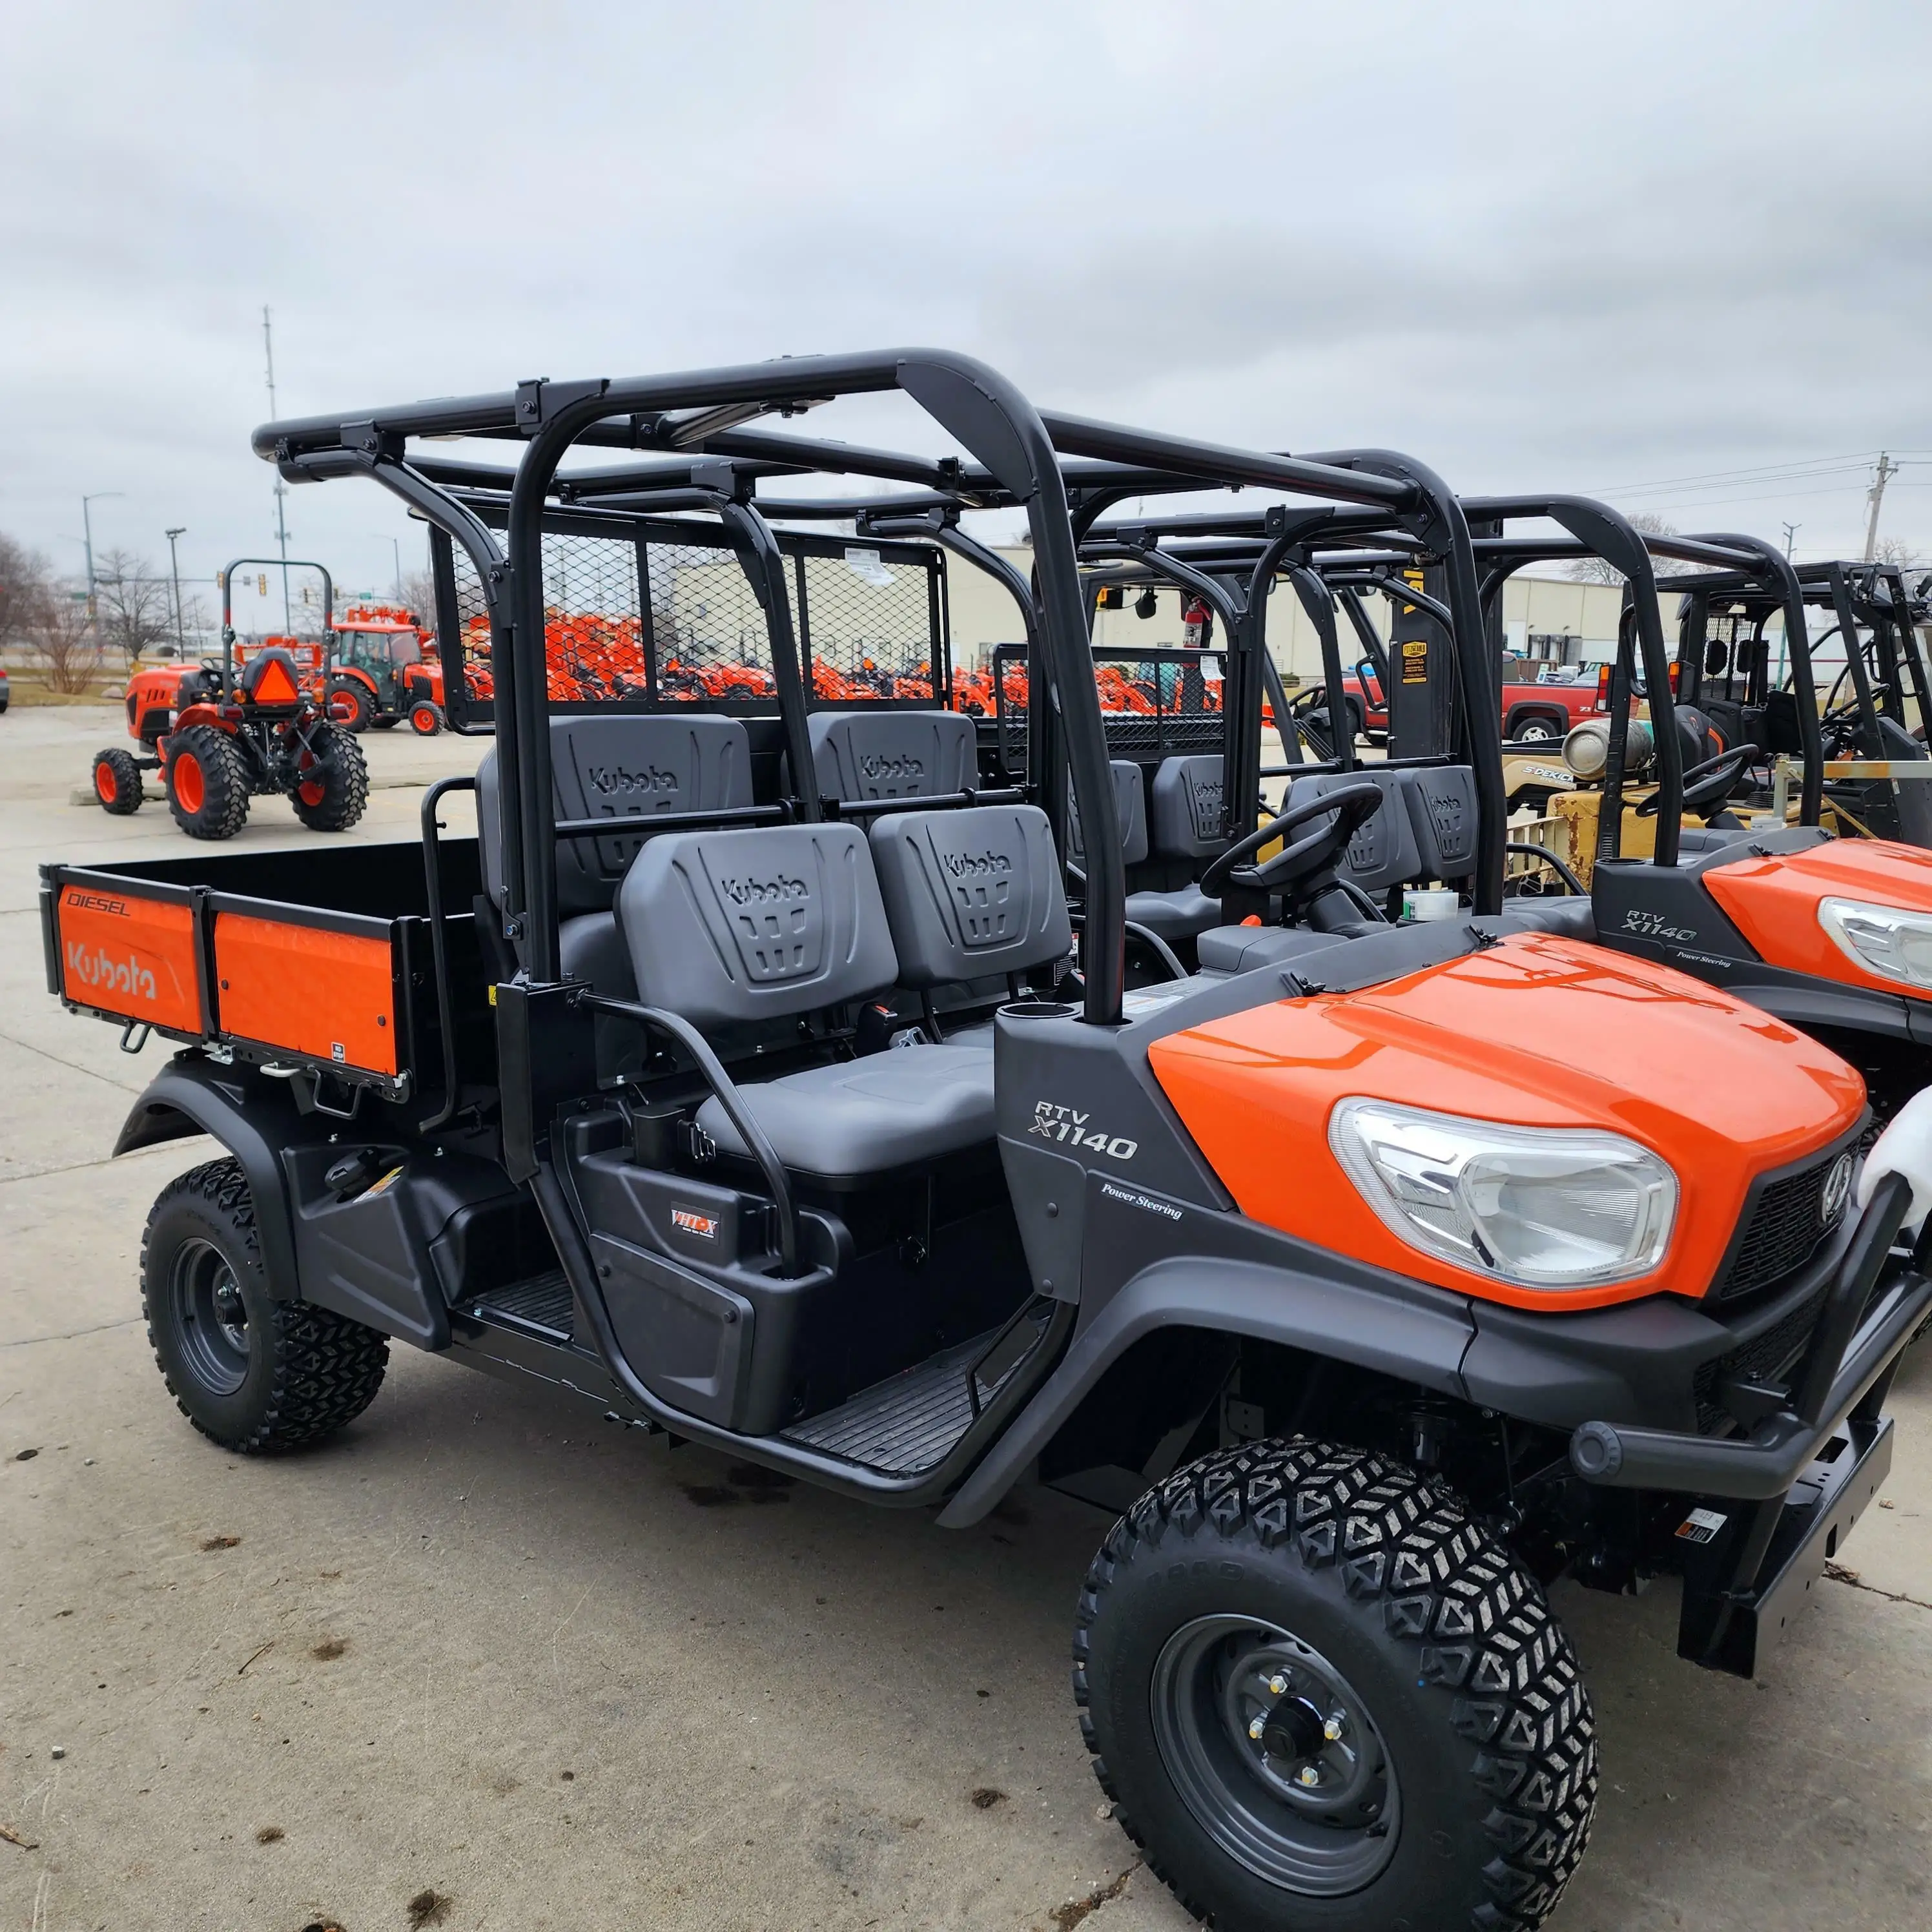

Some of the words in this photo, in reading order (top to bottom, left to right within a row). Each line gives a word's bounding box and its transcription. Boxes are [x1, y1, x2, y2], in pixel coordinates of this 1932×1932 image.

[861, 754, 925, 779] Kubota
[589, 765, 679, 795] Kubota
[943, 850, 1012, 878] Kubota
[721, 874, 810, 907] Kubota
[67, 893, 131, 917] DIESEL
[1627, 910, 1666, 923] RTV
[1620, 918, 1698, 941] X1140
[67, 940, 156, 1000] Kubota
[1676, 951, 1701, 961] Power
[1700, 956, 1732, 968] Steering
[1034, 1100, 1090, 1125] RTV
[1027, 1115, 1138, 1160] X1140
[1102, 1184, 1136, 1203] Power
[1135, 1195, 1183, 1220] Steering
